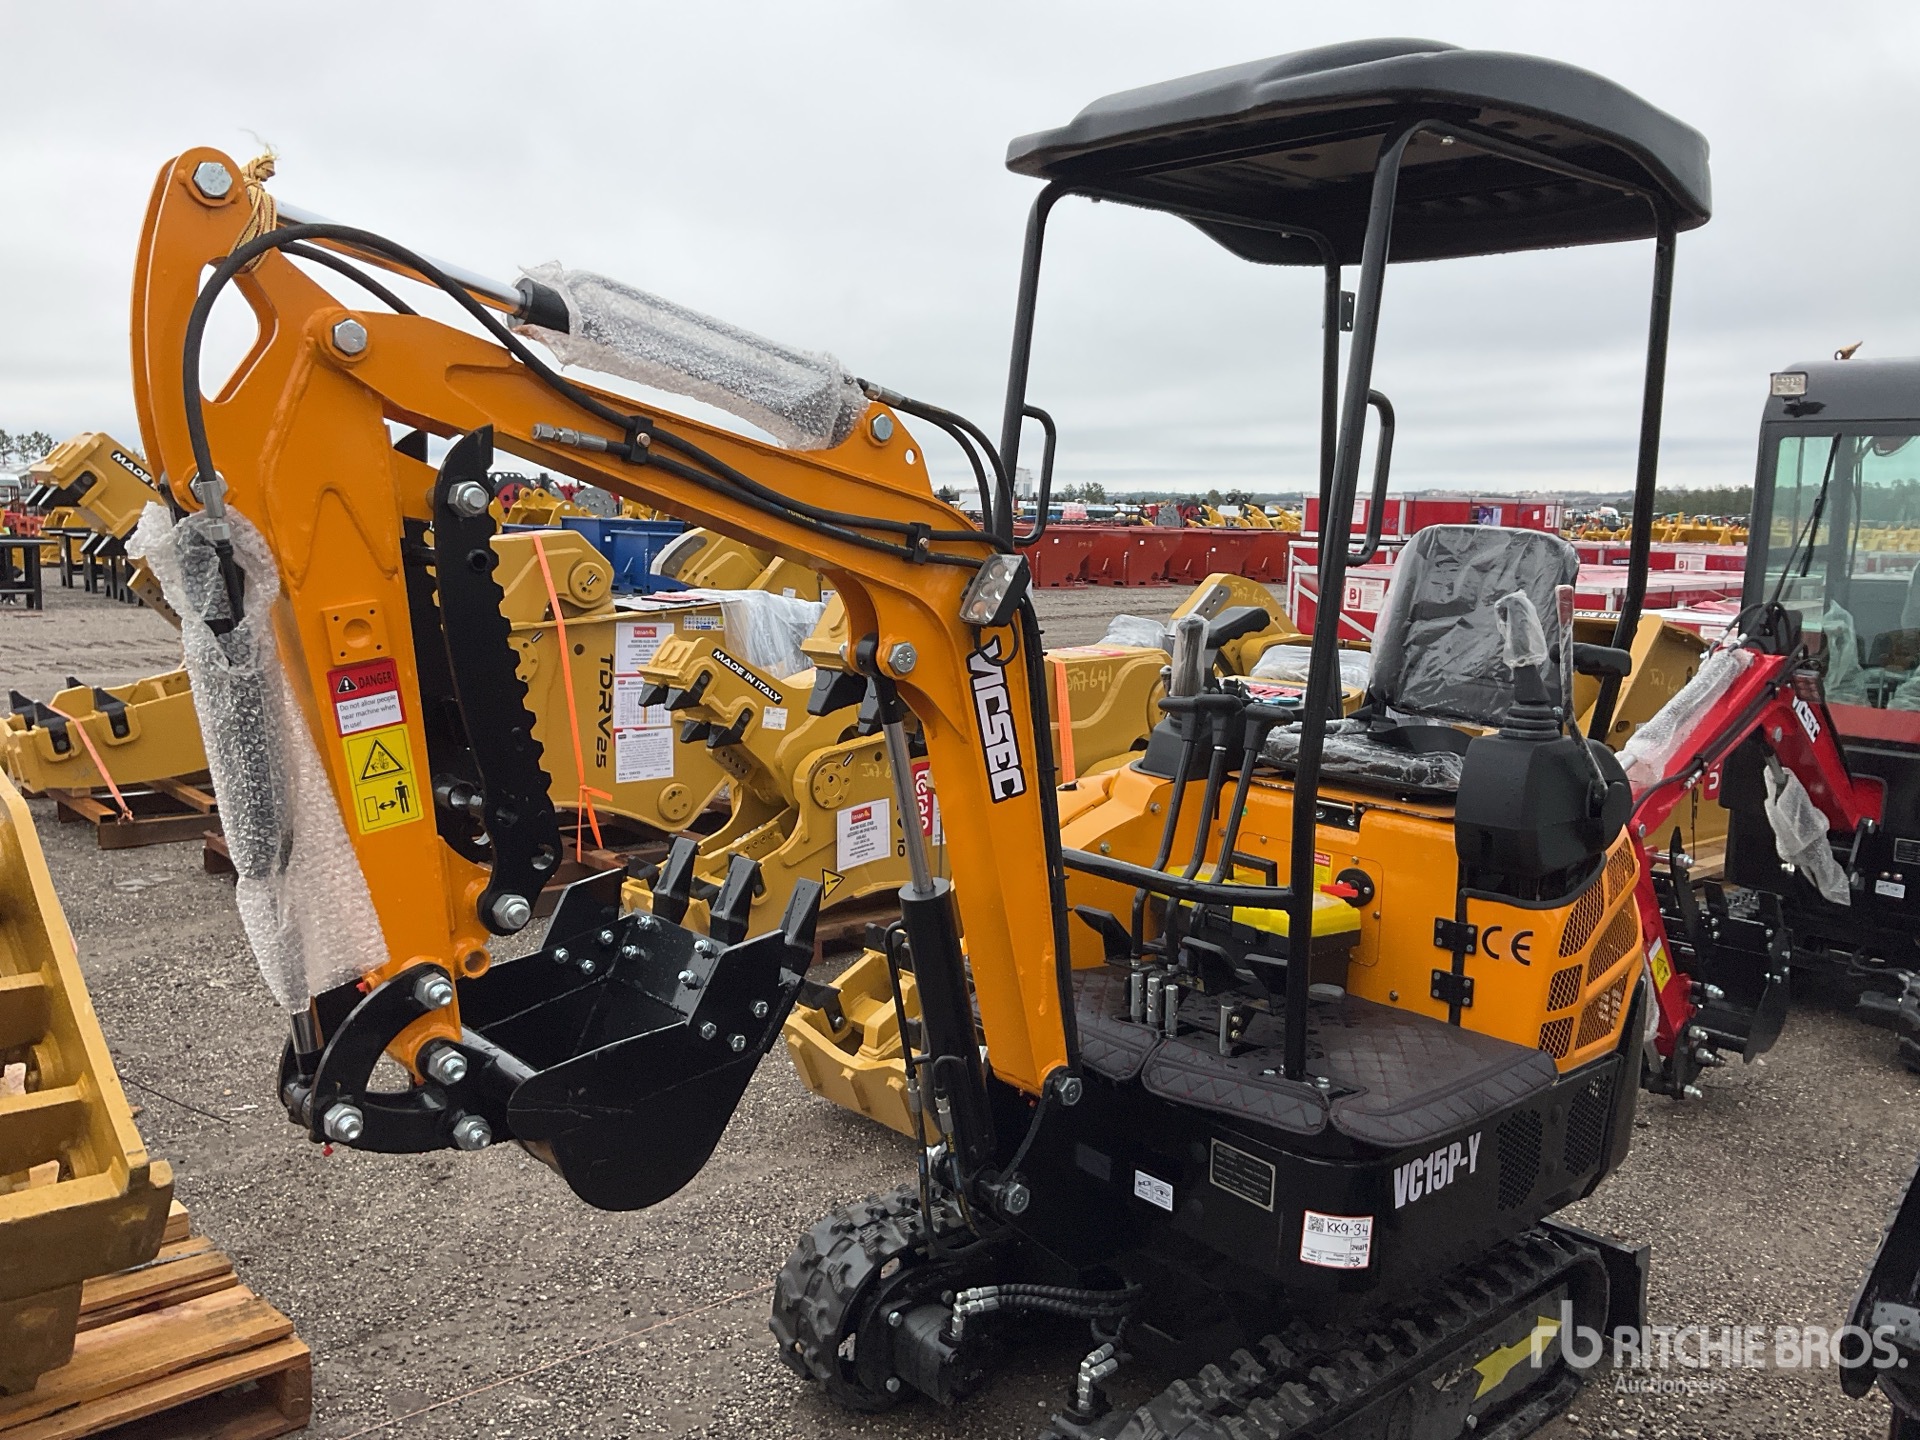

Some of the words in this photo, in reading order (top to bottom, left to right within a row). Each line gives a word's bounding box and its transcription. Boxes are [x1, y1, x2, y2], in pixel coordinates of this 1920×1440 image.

[112, 453, 153, 483] MADE
[1349, 587, 1357, 600] B
[358, 671, 393, 688] DANGER
[713, 650, 745, 676] MADE
[744, 672, 755, 684] IN
[754, 681, 781, 702] ITALY
[340, 704, 349, 712] Do
[350, 702, 360, 710] not
[361, 699, 376, 708] allow
[377, 694, 397, 704] people
[356, 708, 379, 718] machine
[380, 704, 396, 712] when
[1792, 695, 1820, 743] ICSEC
[915, 769, 930, 830] teran
[1393, 1131, 1482, 1210] VC15P-Y
[1326, 1221, 1369, 1237] KK9-34
